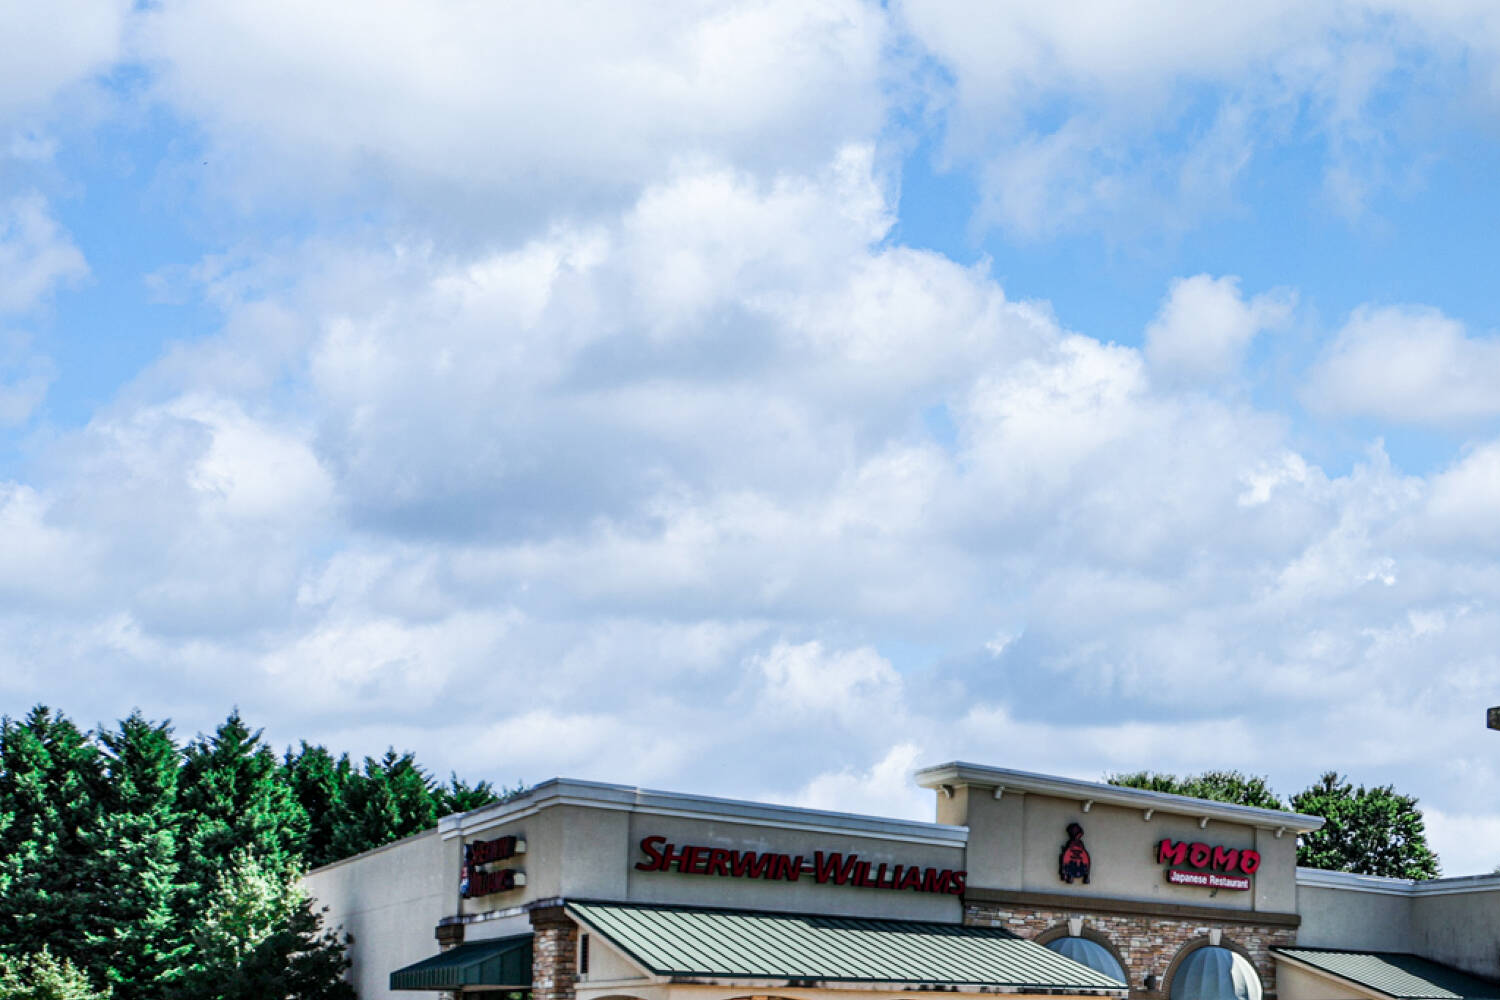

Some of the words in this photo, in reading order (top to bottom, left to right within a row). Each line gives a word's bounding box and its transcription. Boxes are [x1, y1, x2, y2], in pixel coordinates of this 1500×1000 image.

[635, 834, 968, 896] SHERWIN-WILLIAMS
[1158, 837, 1261, 876] MOMO
[1171, 871, 1208, 884] Japanese
[1209, 874, 1249, 889] Restaurant
